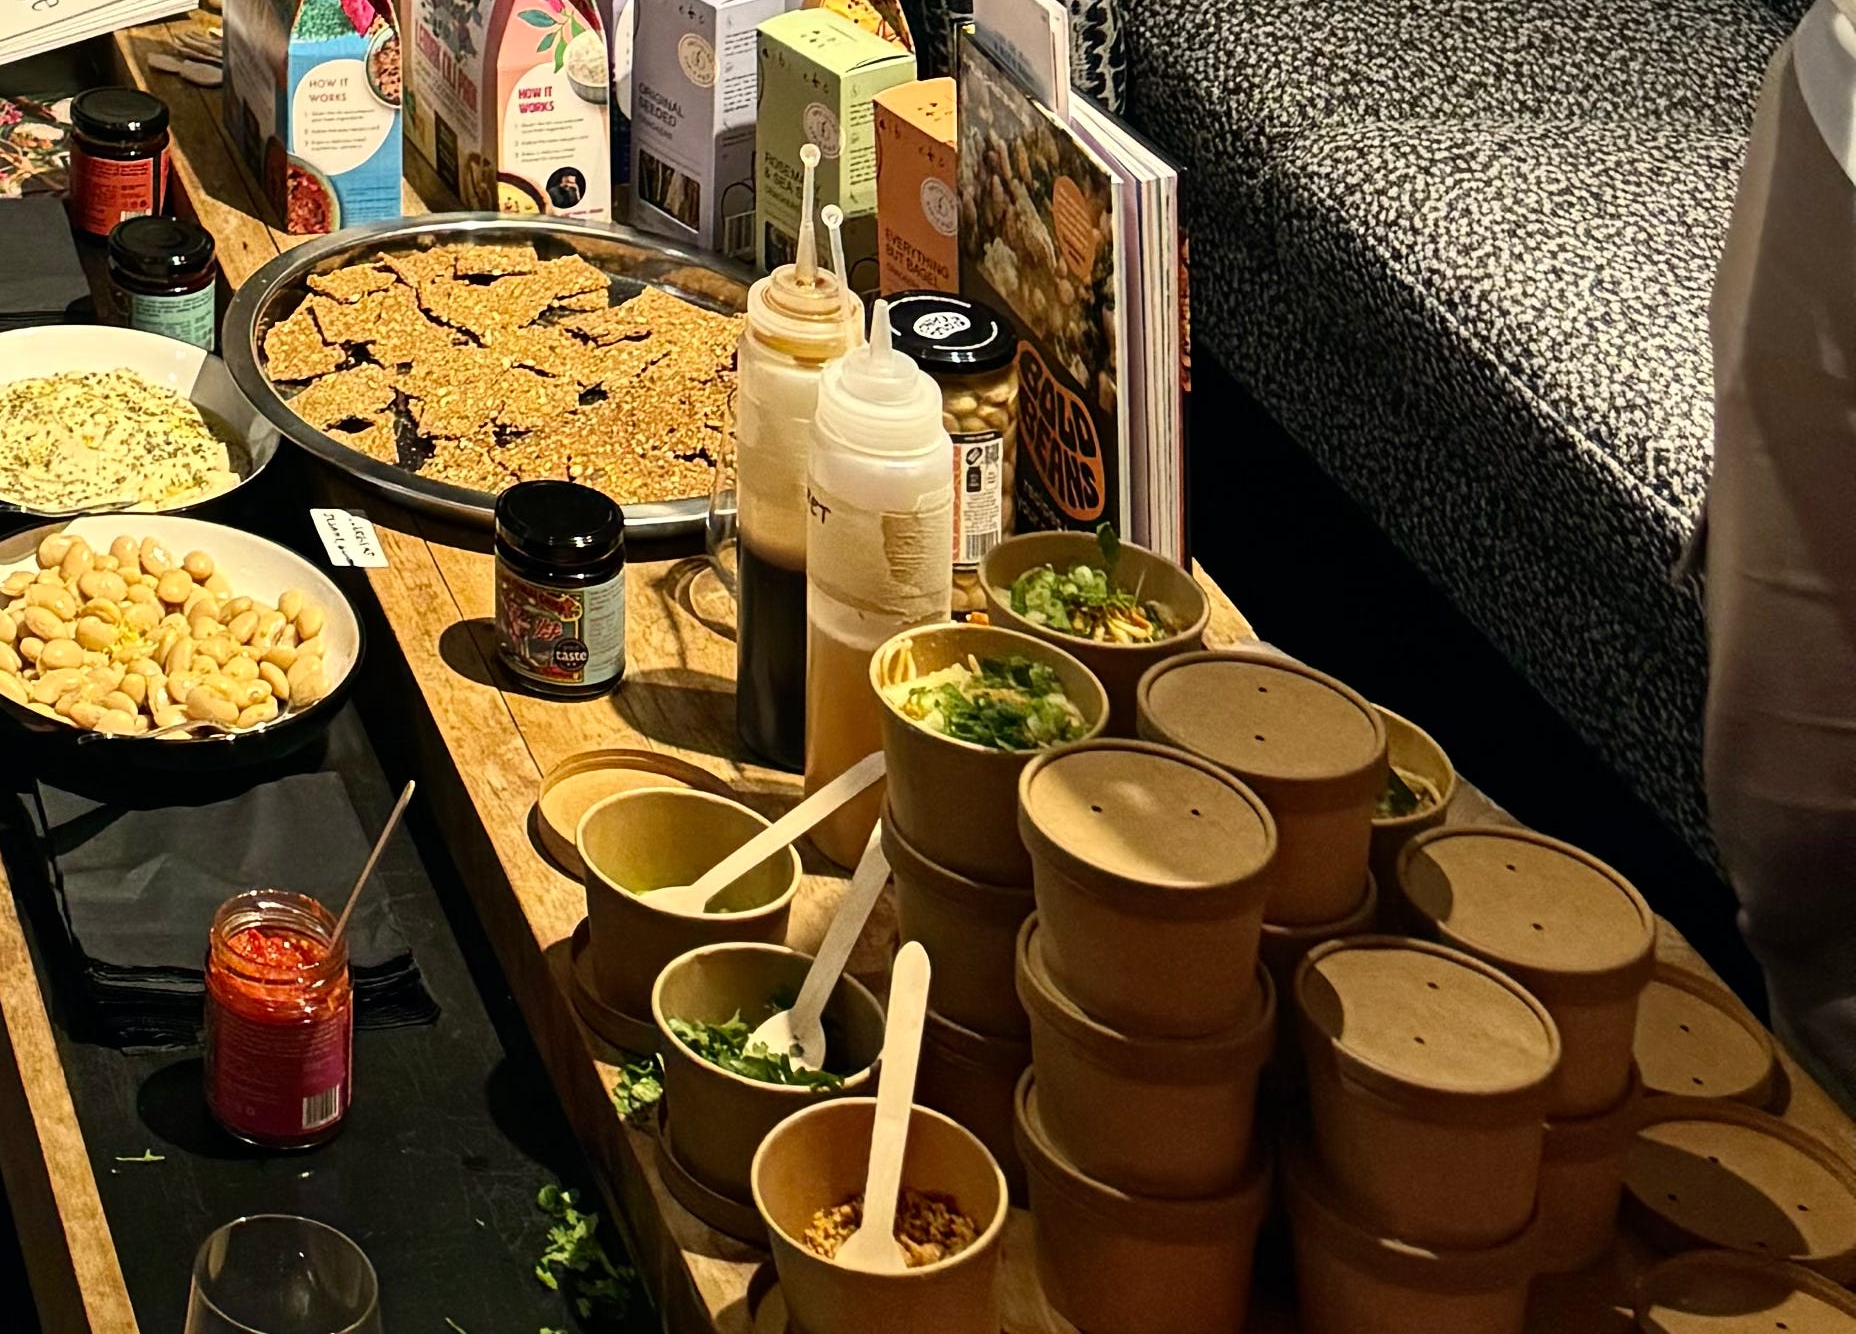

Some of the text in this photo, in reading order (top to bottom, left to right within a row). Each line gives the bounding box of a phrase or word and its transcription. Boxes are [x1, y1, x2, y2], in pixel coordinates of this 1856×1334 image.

[309, 78, 337, 88] HOW
[309, 93, 347, 103] WORKS
[518, 86, 553, 99] HOW IT
[639, 82, 685, 119] ORIGINAL
[519, 101, 554, 114] WORKS
[1019, 350, 1097, 458] BOLD
[1019, 384, 1100, 510] BEANS
[555, 650, 587, 662] taste
